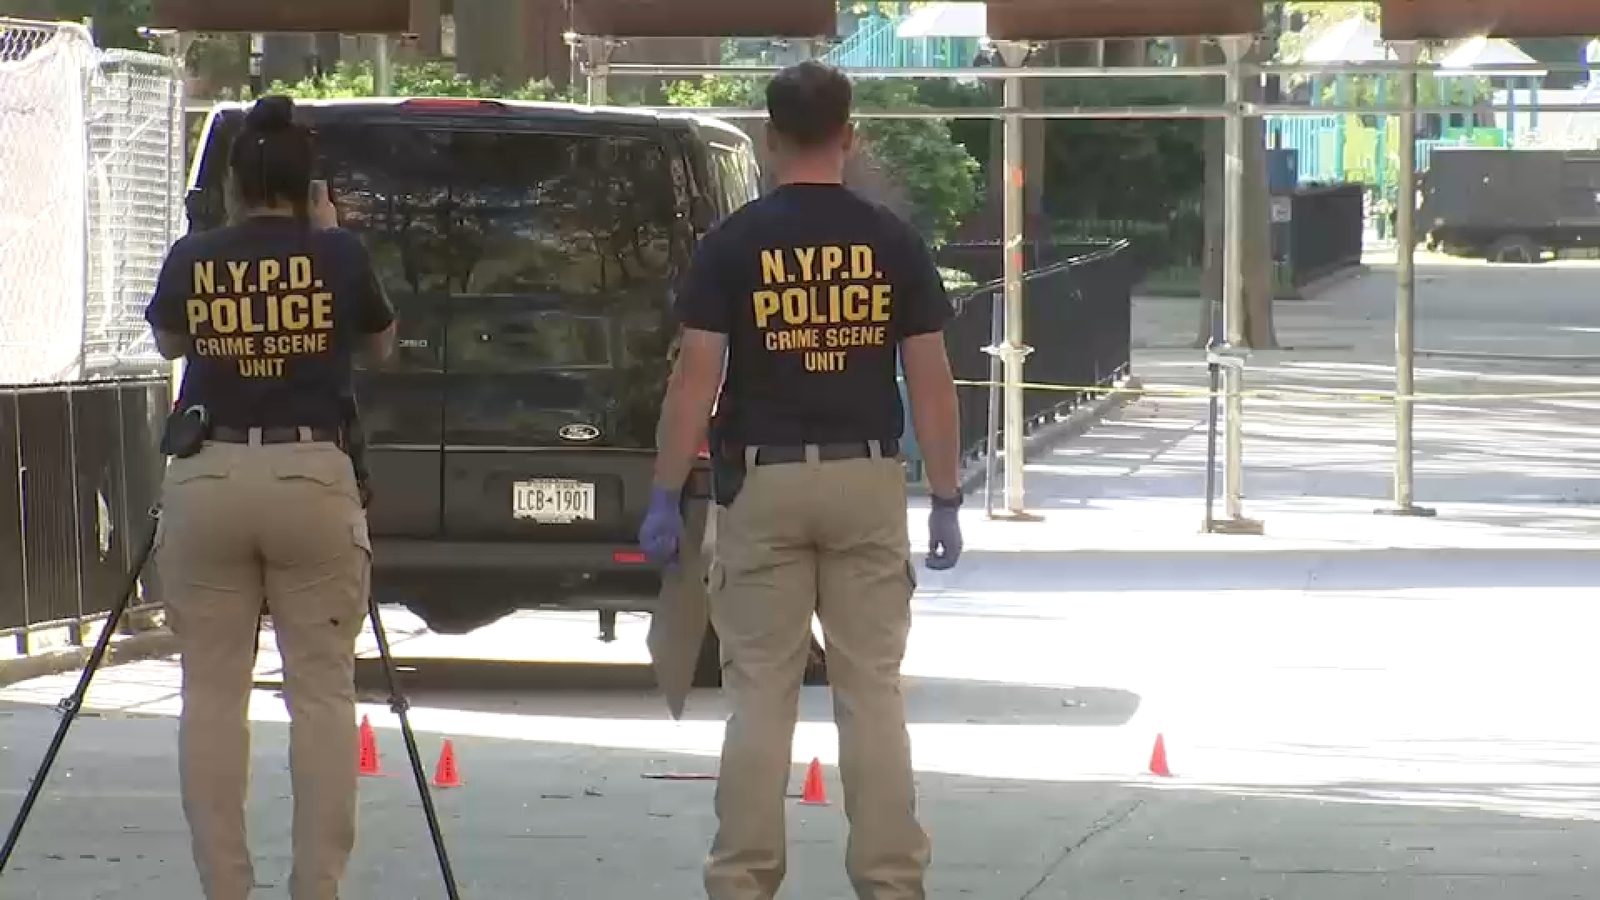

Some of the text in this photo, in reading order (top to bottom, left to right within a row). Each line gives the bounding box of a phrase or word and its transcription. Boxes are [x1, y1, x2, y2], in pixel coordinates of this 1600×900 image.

[194, 255, 324, 294] N.Y.P.D.
[761, 244, 883, 284] N.Y.P.D.
[186, 292, 334, 334] POLICE
[752, 284, 892, 328] POLICE
[195, 333, 327, 356] CRIME SCENE
[765, 326, 886, 351] CRIME SCENE
[238, 358, 285, 377] UNIT
[804, 351, 846, 372] UNIT
